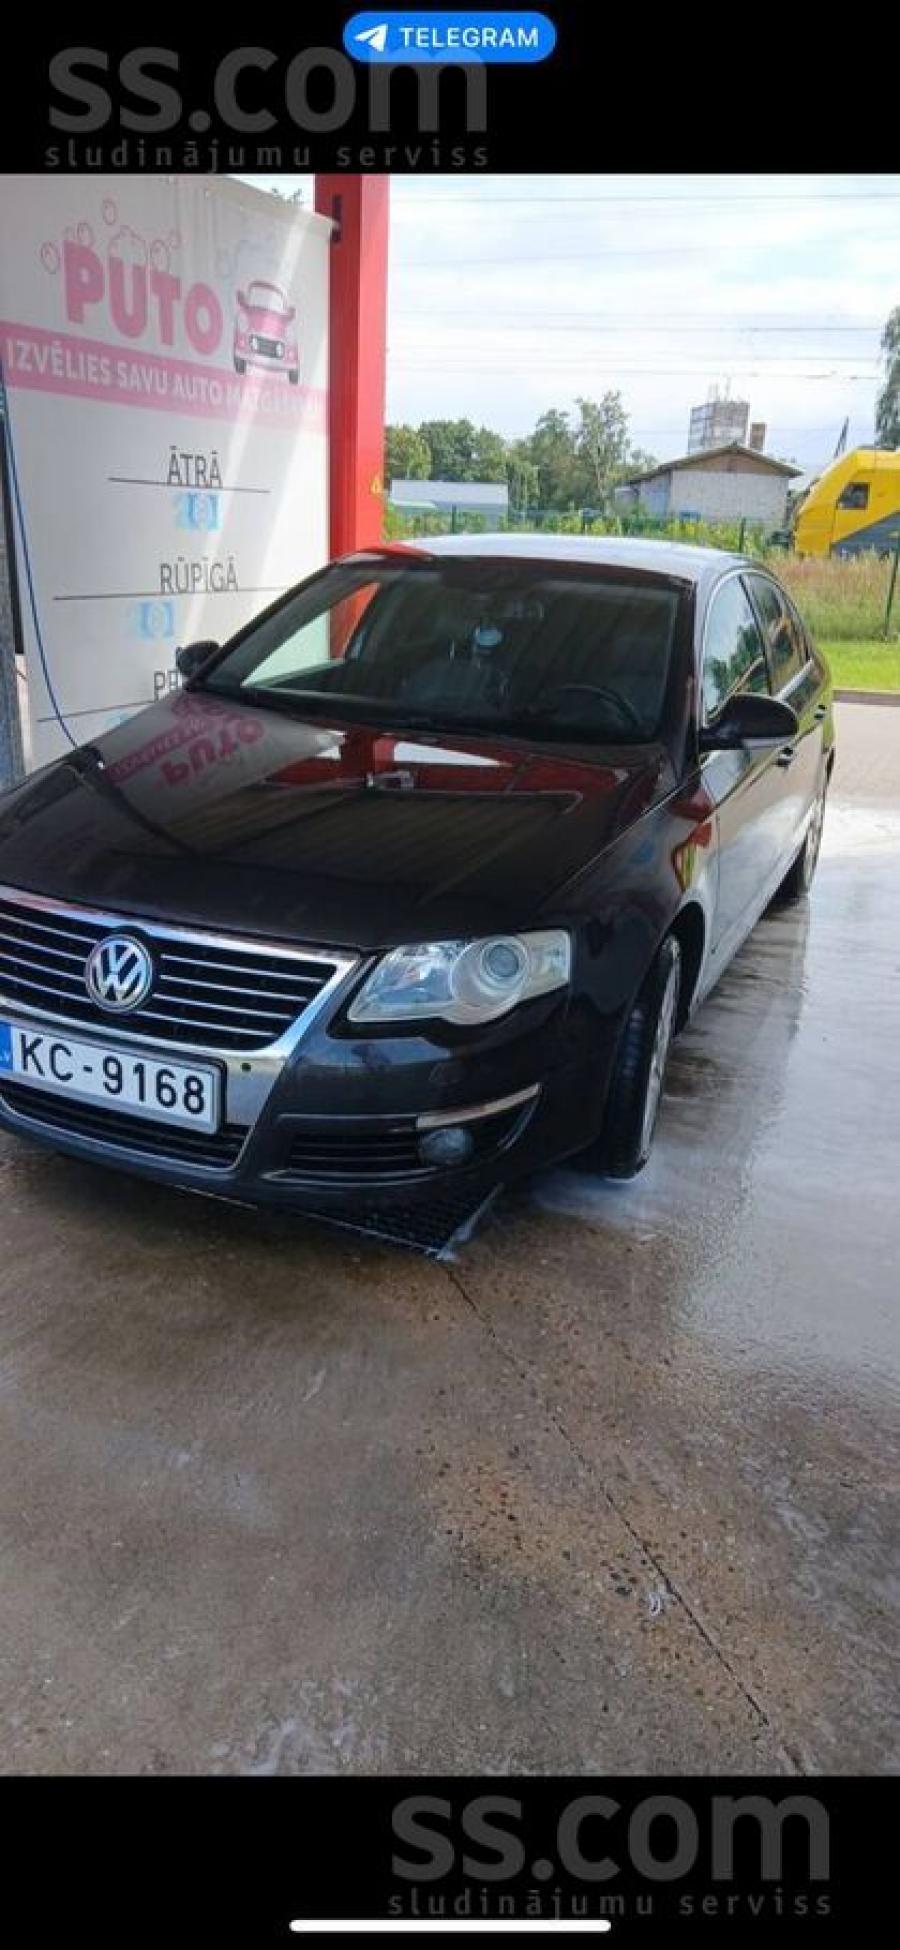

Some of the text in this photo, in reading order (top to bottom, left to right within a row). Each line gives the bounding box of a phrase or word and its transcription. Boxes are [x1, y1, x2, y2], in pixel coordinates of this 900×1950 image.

[62, 240, 223, 355] PUTO
[6, 339, 111, 388] IZVĒLIES
[116, 360, 169, 393] SAVU
[173, 373, 223, 402] AUTO
[167, 446, 223, 488] ĀTRĀ
[159, 556, 239, 593] RŪPĪGĀ
[20, 1033, 205, 1115] KC-9168
